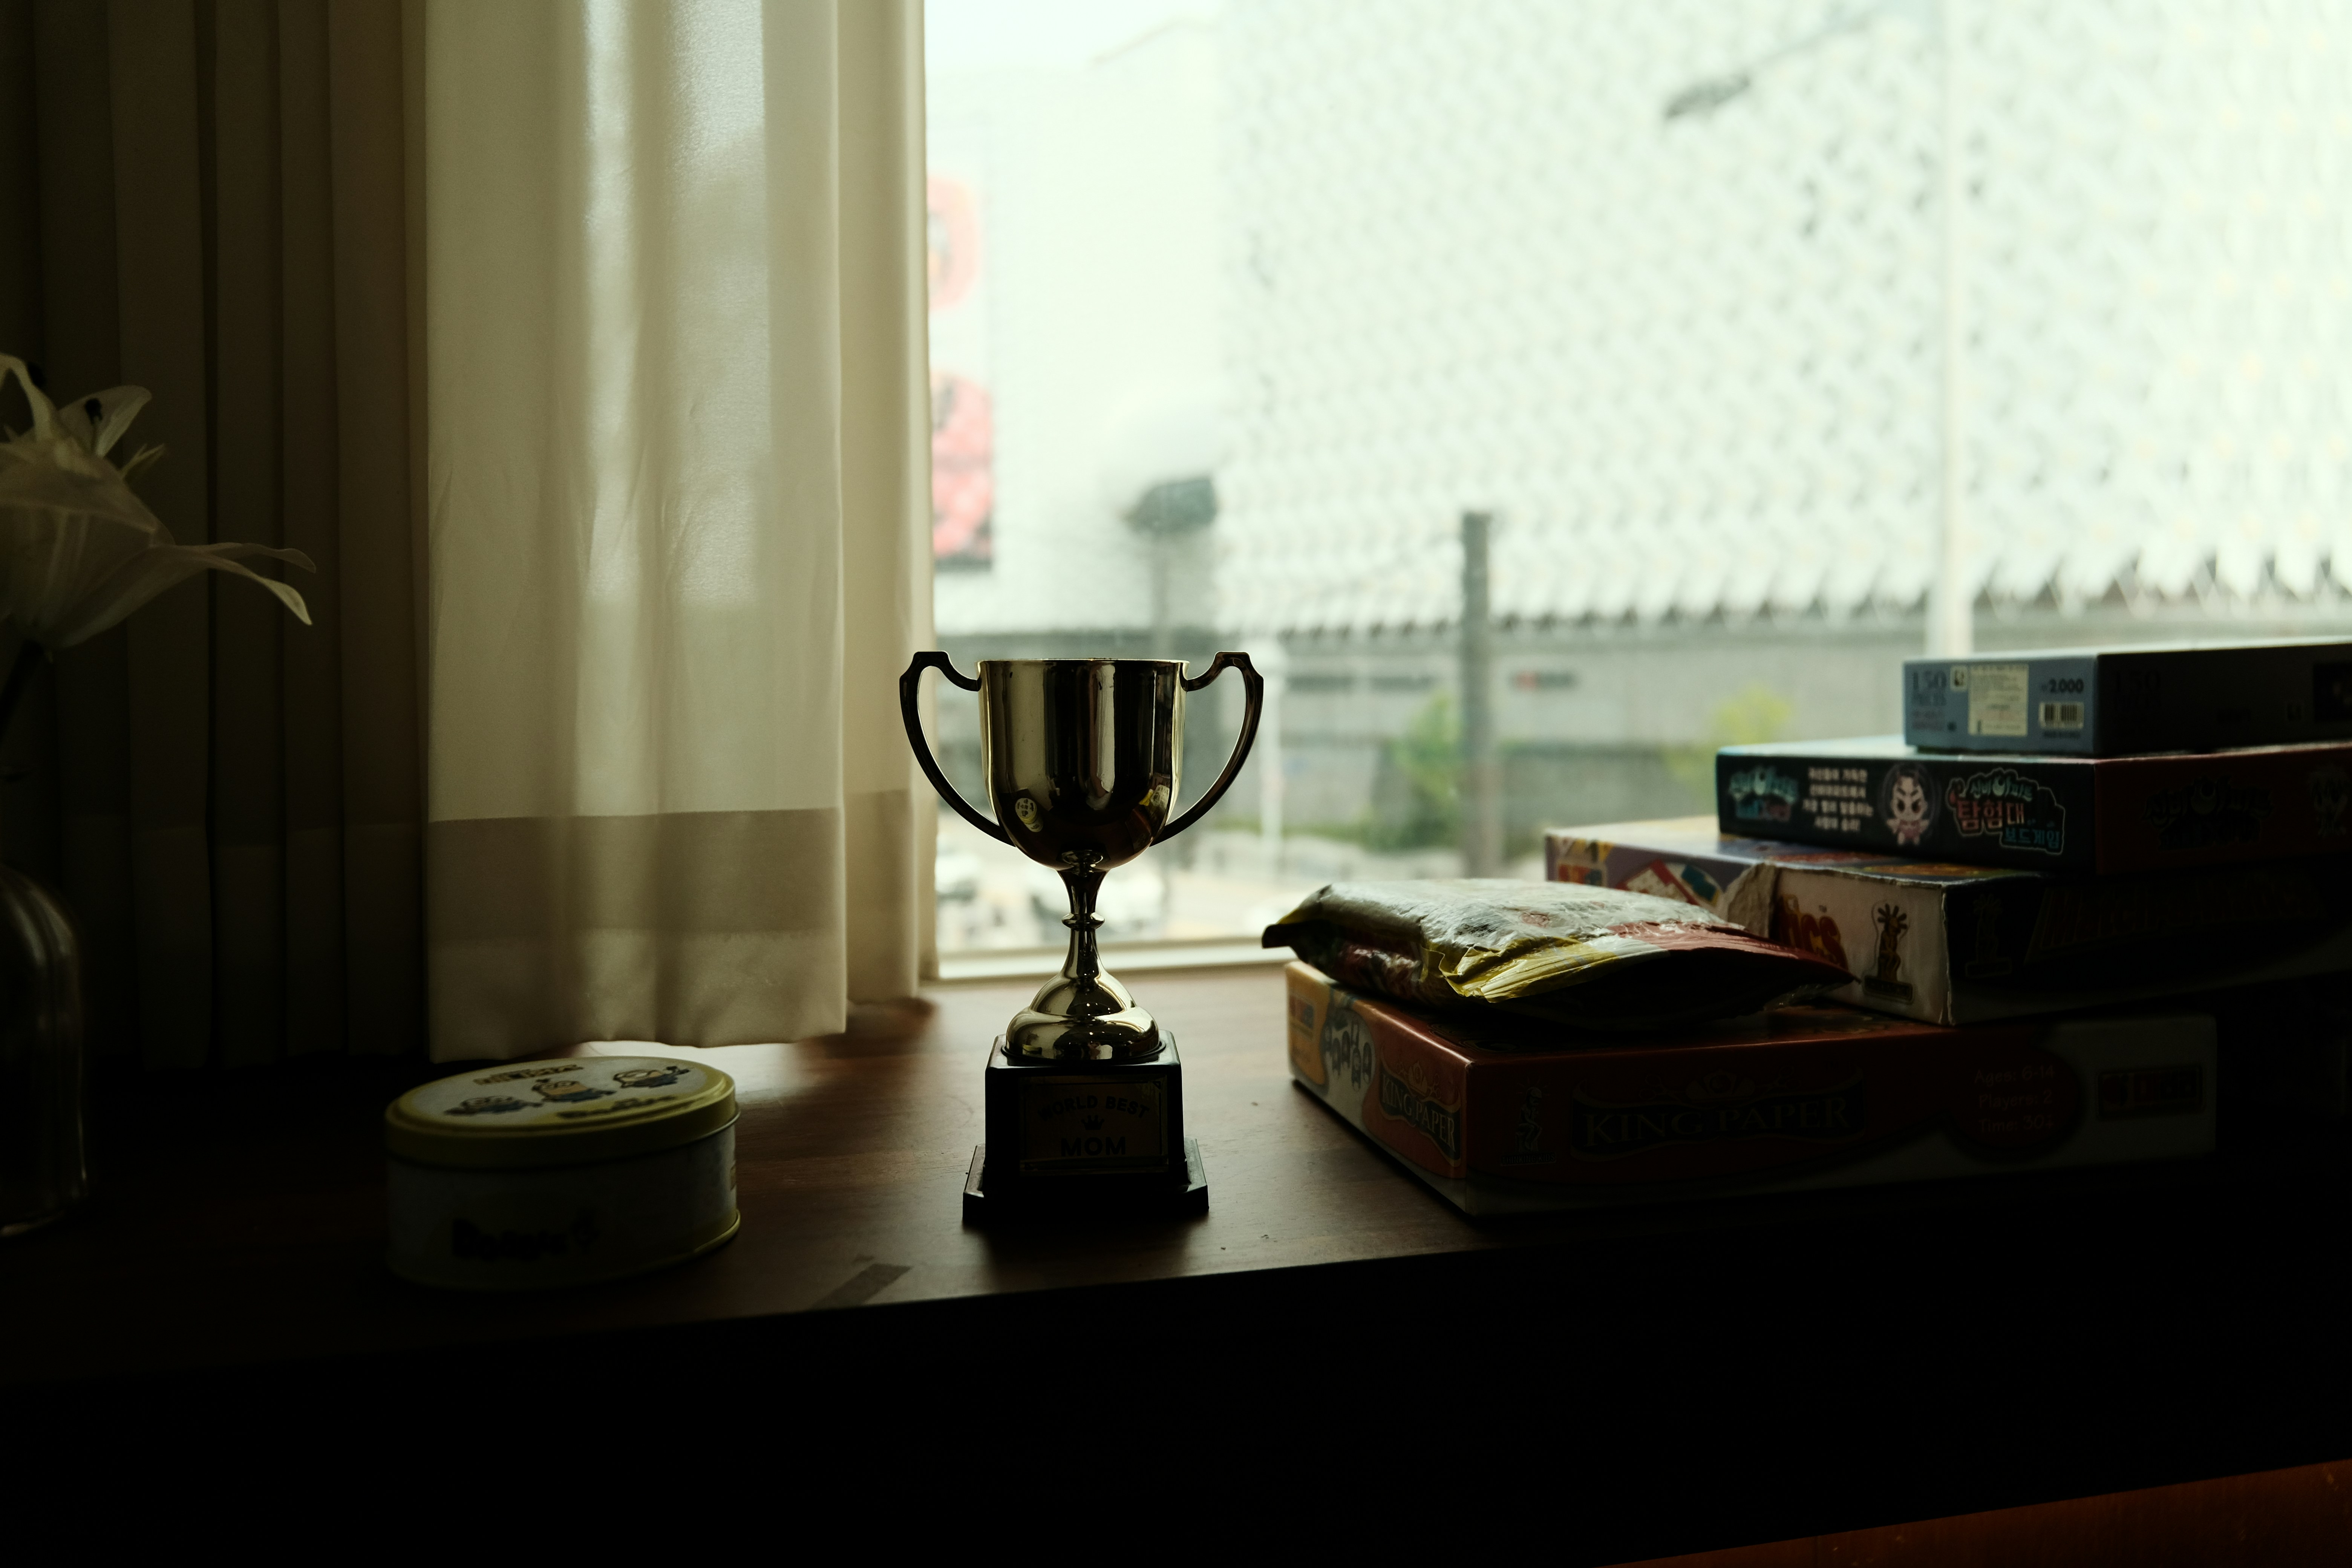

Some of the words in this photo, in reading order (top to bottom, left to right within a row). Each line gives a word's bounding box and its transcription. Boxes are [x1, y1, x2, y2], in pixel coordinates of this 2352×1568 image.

[1957, 799, 2025, 831] 탐험대
[1974, 1069, 2017, 1088] Ages:
[2022, 1064, 2055, 1081] 6-14
[1037, 1095, 1098, 1121] WORLD
[1106, 1096, 1150, 1118] BEST
[1979, 1093, 2038, 1111] Players:
[2043, 1089, 2052, 1104] 2
[1381, 1077, 1413, 1116] KING
[1415, 1101, 1456, 1153] PAPER
[1585, 1113, 1704, 1147] KING
[1719, 1096, 1851, 1132] PAPER
[1979, 1118, 2017, 1133] Time:
[1061, 1136, 1126, 1156] MOM
[1538, 1152, 1556, 1162] KIDS
